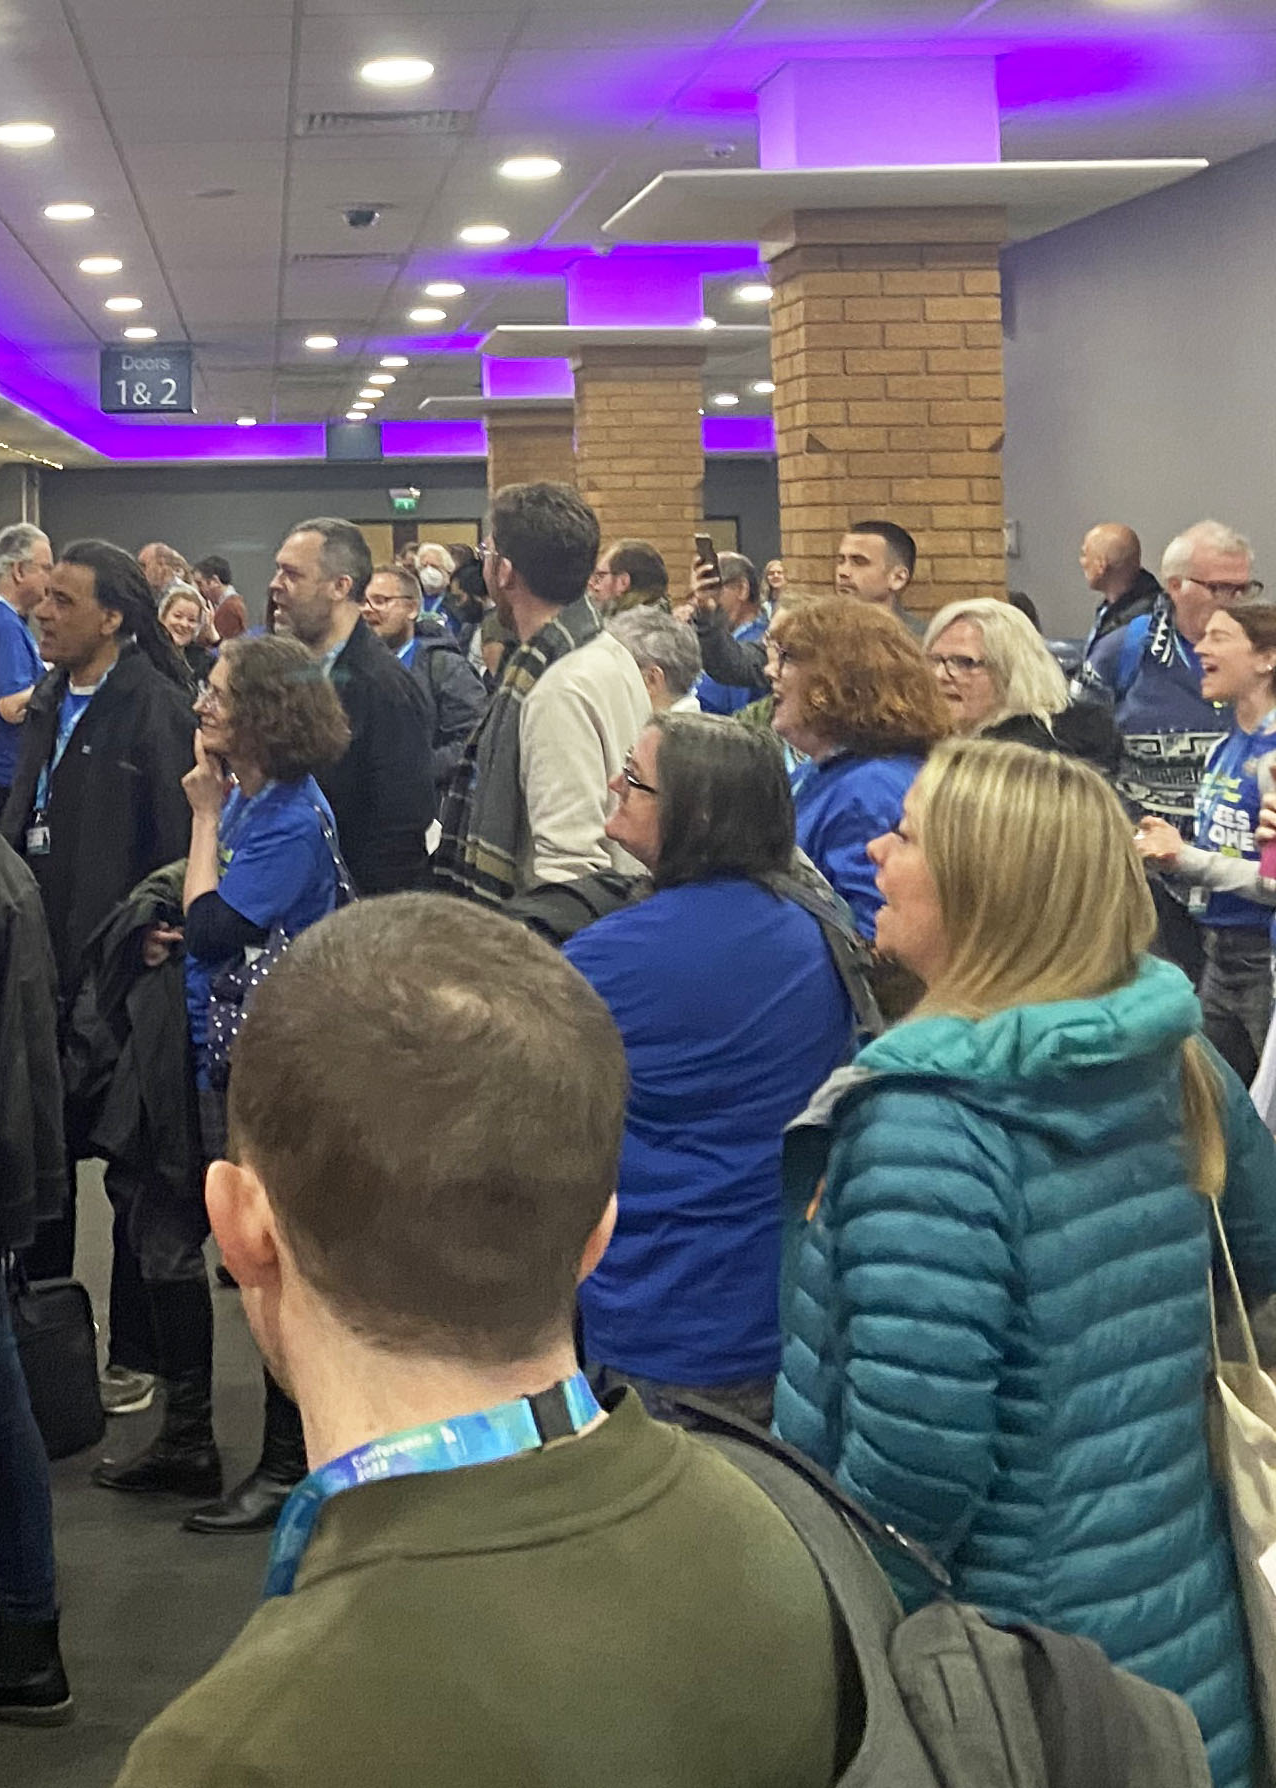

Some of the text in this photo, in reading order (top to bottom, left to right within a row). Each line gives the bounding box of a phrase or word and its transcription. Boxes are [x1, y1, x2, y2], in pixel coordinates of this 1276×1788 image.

[121, 355, 171, 371] Doors
[116, 378, 178, 406] 1 & 2
